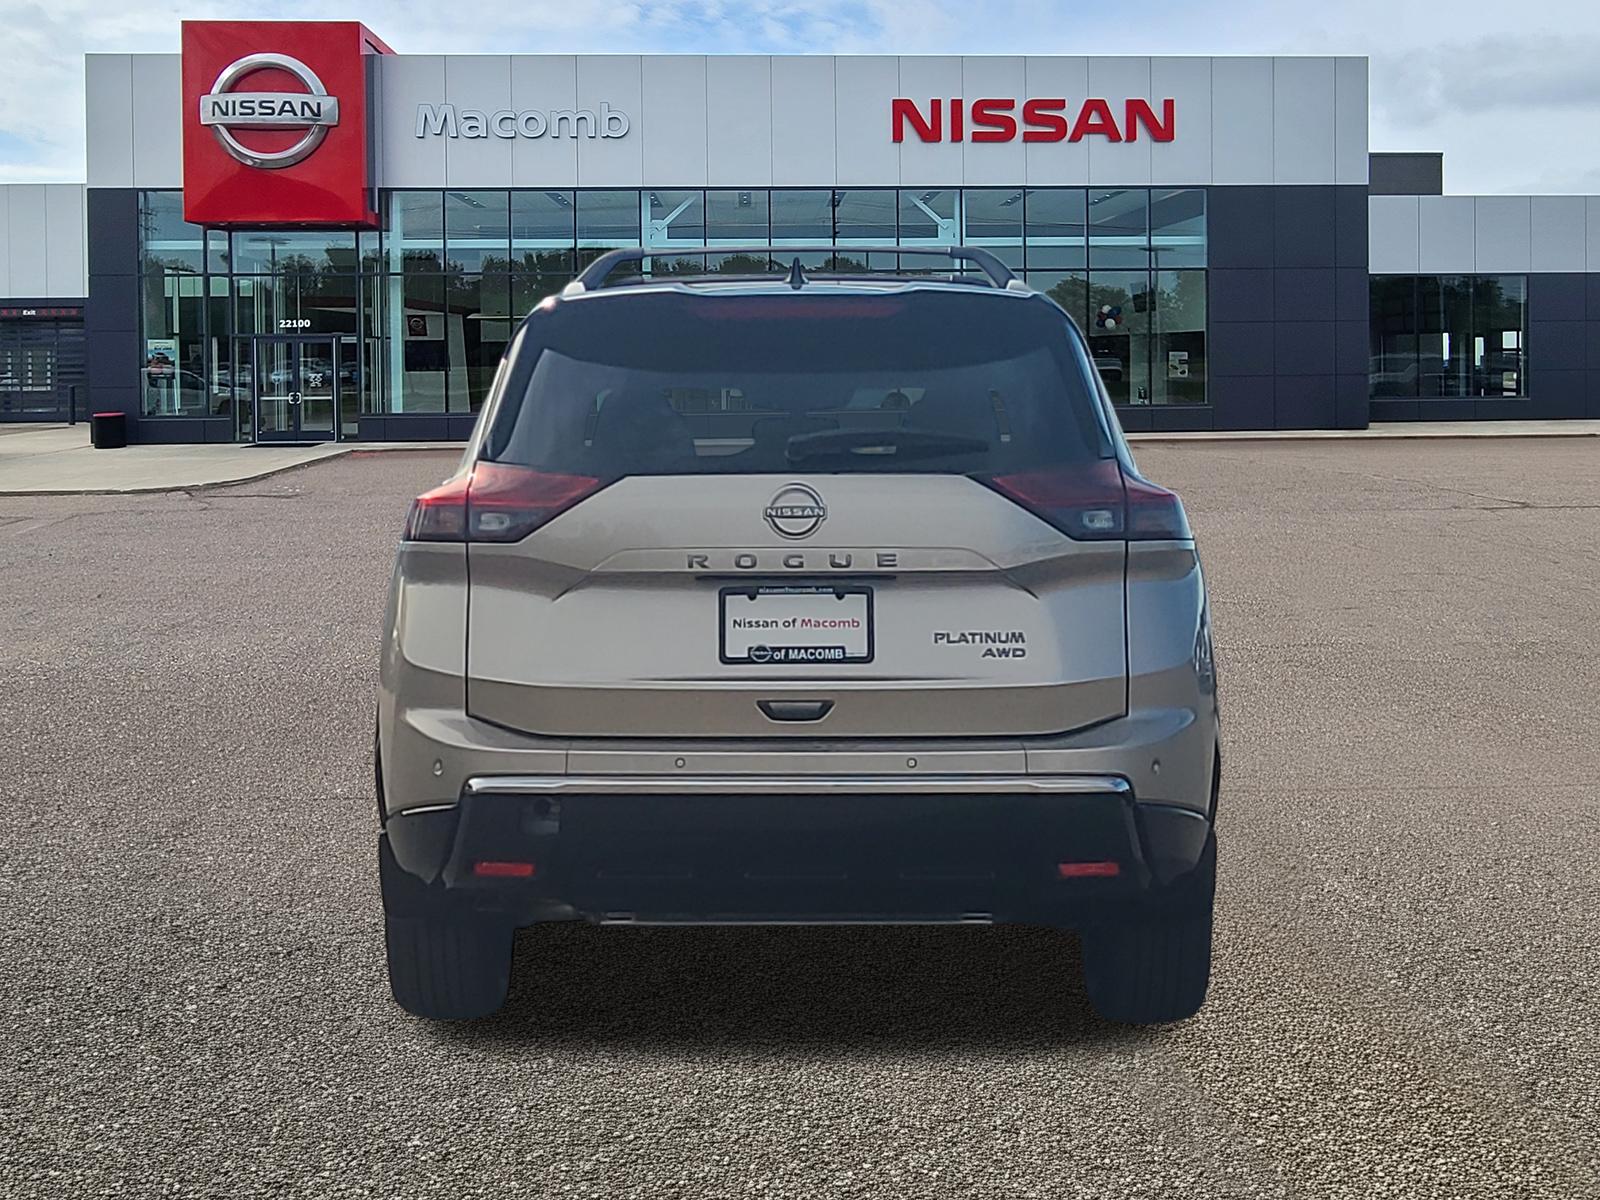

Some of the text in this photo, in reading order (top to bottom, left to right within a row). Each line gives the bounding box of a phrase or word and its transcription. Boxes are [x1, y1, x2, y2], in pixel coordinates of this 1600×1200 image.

[211, 100, 322, 118] NISSAN
[415, 102, 631, 139] Macomb
[892, 98, 1175, 143] NISSAN
[279, 319, 311, 328] 22100
[766, 507, 825, 517] NISSAN
[687, 553, 898, 569] ROGUE
[732, 617, 860, 629] Nissan of Macomb
[933, 631, 1026, 644] PLATINUM
[773, 648, 786, 660] of
[788, 648, 844, 660] MACOMB
[981, 647, 1026, 658] AWD
